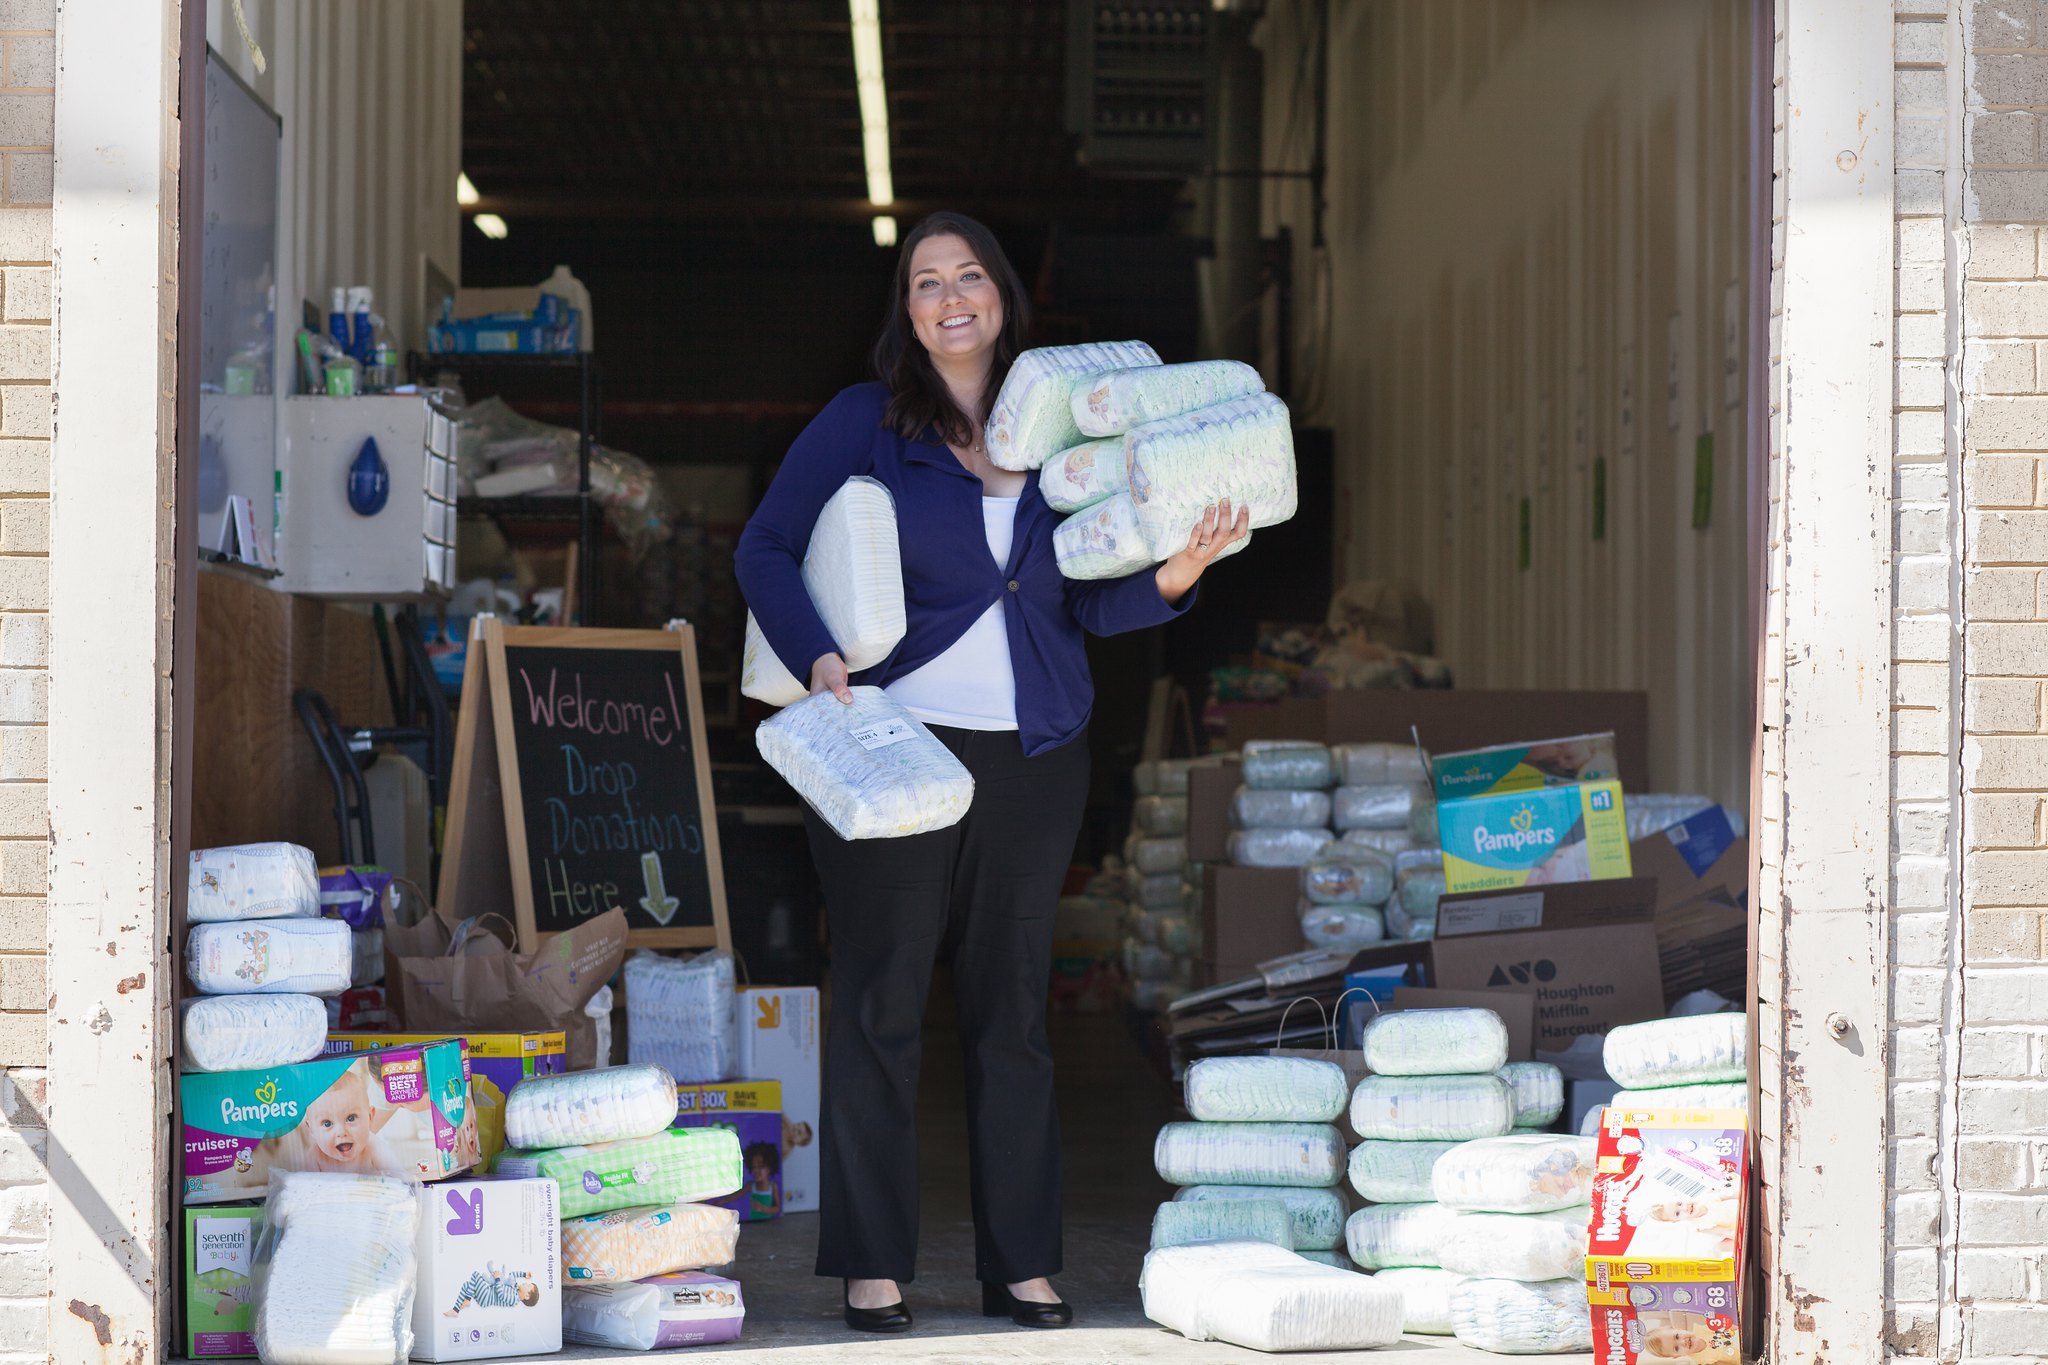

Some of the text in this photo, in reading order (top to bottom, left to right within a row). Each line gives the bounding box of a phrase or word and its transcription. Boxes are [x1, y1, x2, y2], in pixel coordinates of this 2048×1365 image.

[519, 667, 688, 752] Welcome!
[560, 744, 637, 808] Drop
[1442, 771, 1493, 786] Pampers
[1592, 791, 1611, 808] #1
[545, 796, 702, 855] Donations
[1473, 825, 1555, 854] Pampers
[545, 858, 628, 917] Here
[1453, 876, 1515, 892] swaddlers
[1536, 983, 1615, 1001] Houghton
[1540, 1003, 1589, 1020] Mifflin
[1541, 1021, 1609, 1038] Harcourt
[322, 1040, 353, 1055] ALUE!
[388, 1073, 418, 1082] PAMPERS
[389, 1080, 418, 1091] BEST
[390, 1087, 419, 1096] DRYNESS
[699, 1091, 727, 1108] BOX
[220, 1097, 298, 1125] Pampers
[443, 1091, 464, 1115] Pampers
[185, 1137, 239, 1153] cruisers
[1713, 1137, 1733, 1156] 68
[202, 1231, 245, 1243] seventh
[546, 1183, 555, 1290] overnight baby diapers
[202, 1242, 245, 1251] generation
[1626, 1262, 1652, 1279] $10
[1706, 1286, 1725, 1308] 68
[1709, 1318, 1722, 1327] 3
[453, 1332, 461, 1343] 54
[1606, 1309, 1627, 1365] HUGGIES
[1630, 1320, 1643, 1351] Movers
